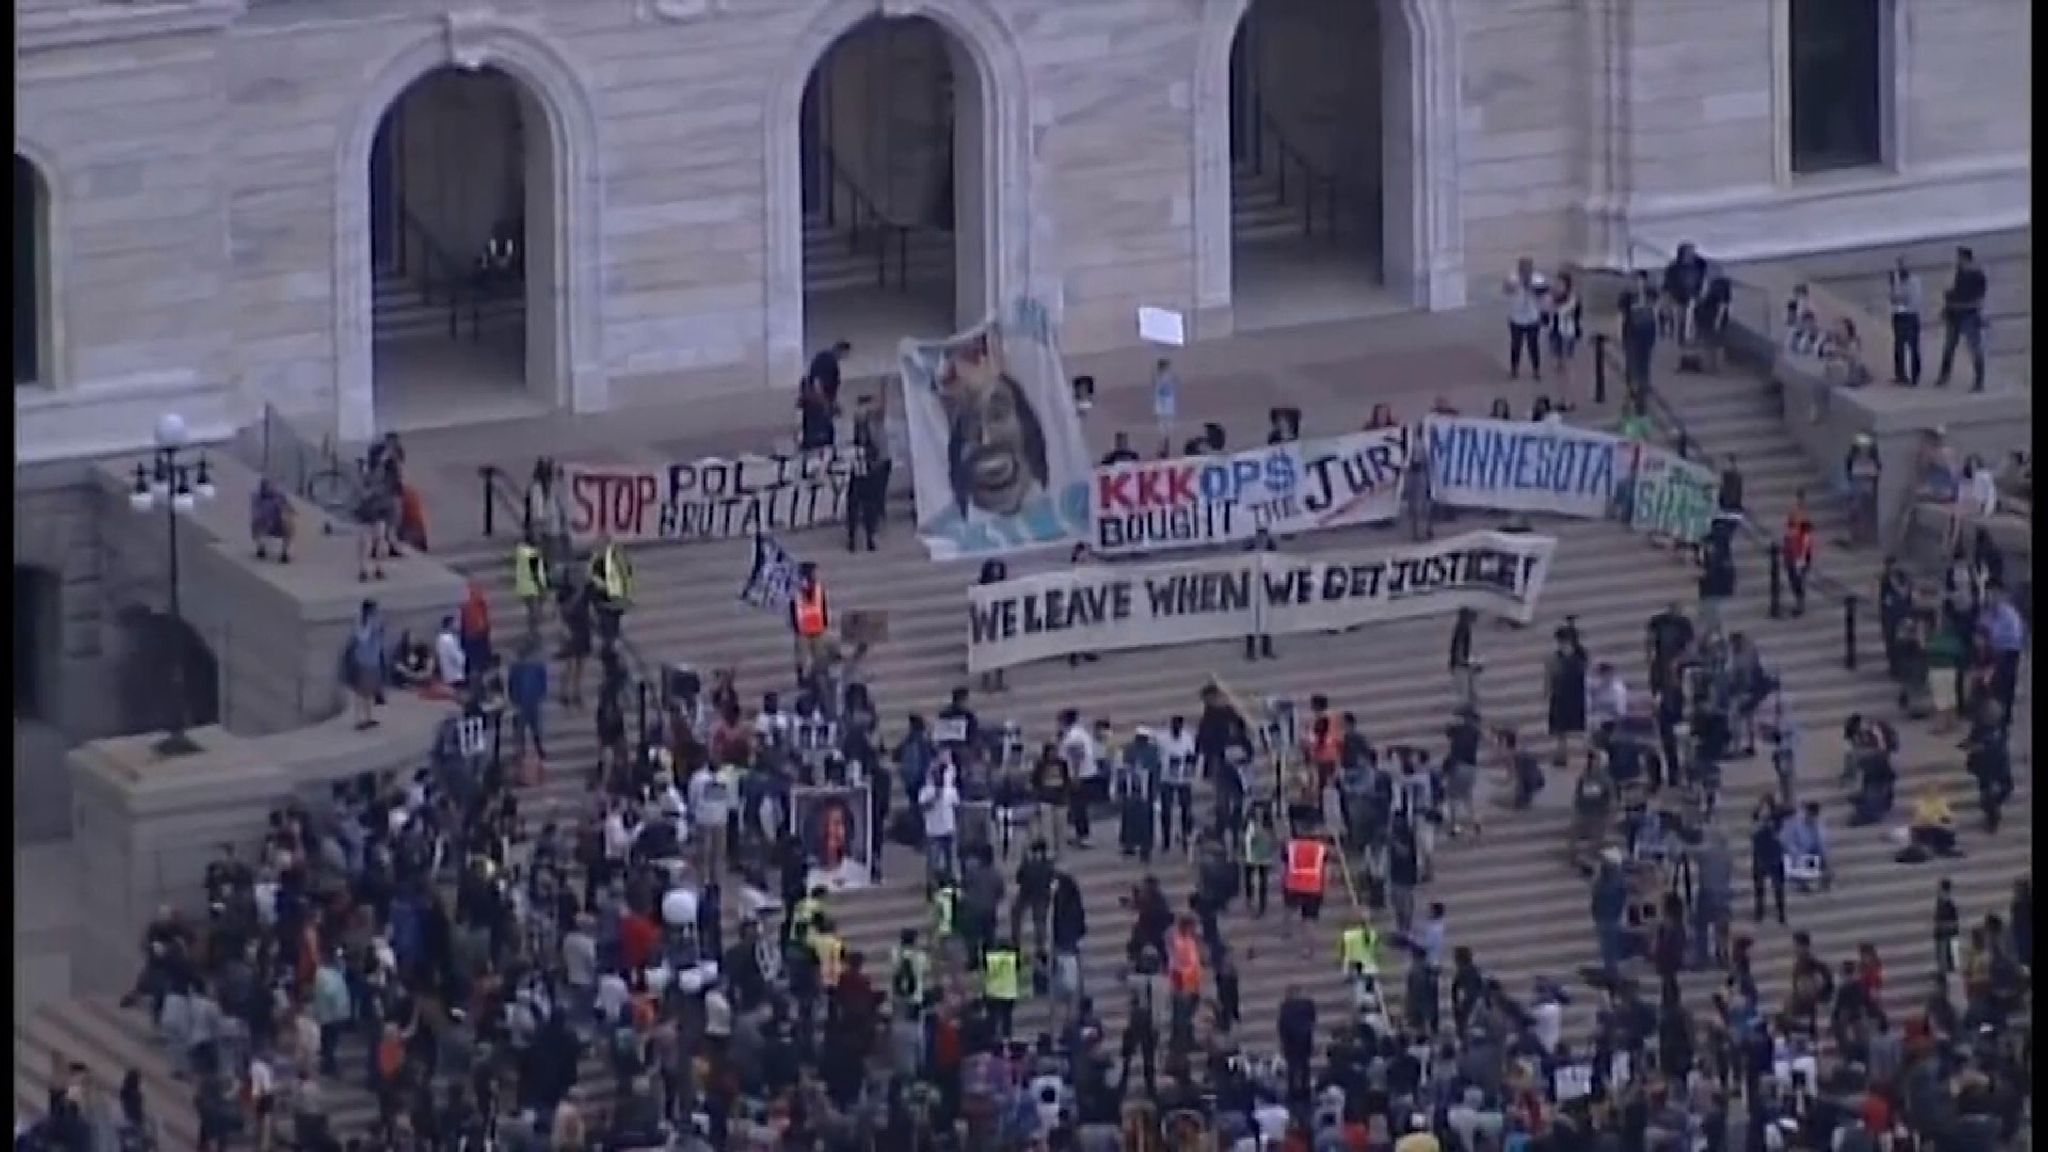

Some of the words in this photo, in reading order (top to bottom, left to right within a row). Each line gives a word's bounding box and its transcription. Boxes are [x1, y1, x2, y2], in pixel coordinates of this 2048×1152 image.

[1429, 424, 1615, 497] MINNESOTA
[571, 472, 657, 535] STOP
[1100, 496, 1239, 547] BOUGHT
[969, 599, 1017, 644] WE
[1024, 581, 1132, 633] LEAVE
[1147, 569, 1251, 618] WHEN
[1263, 569, 1312, 606] WE
